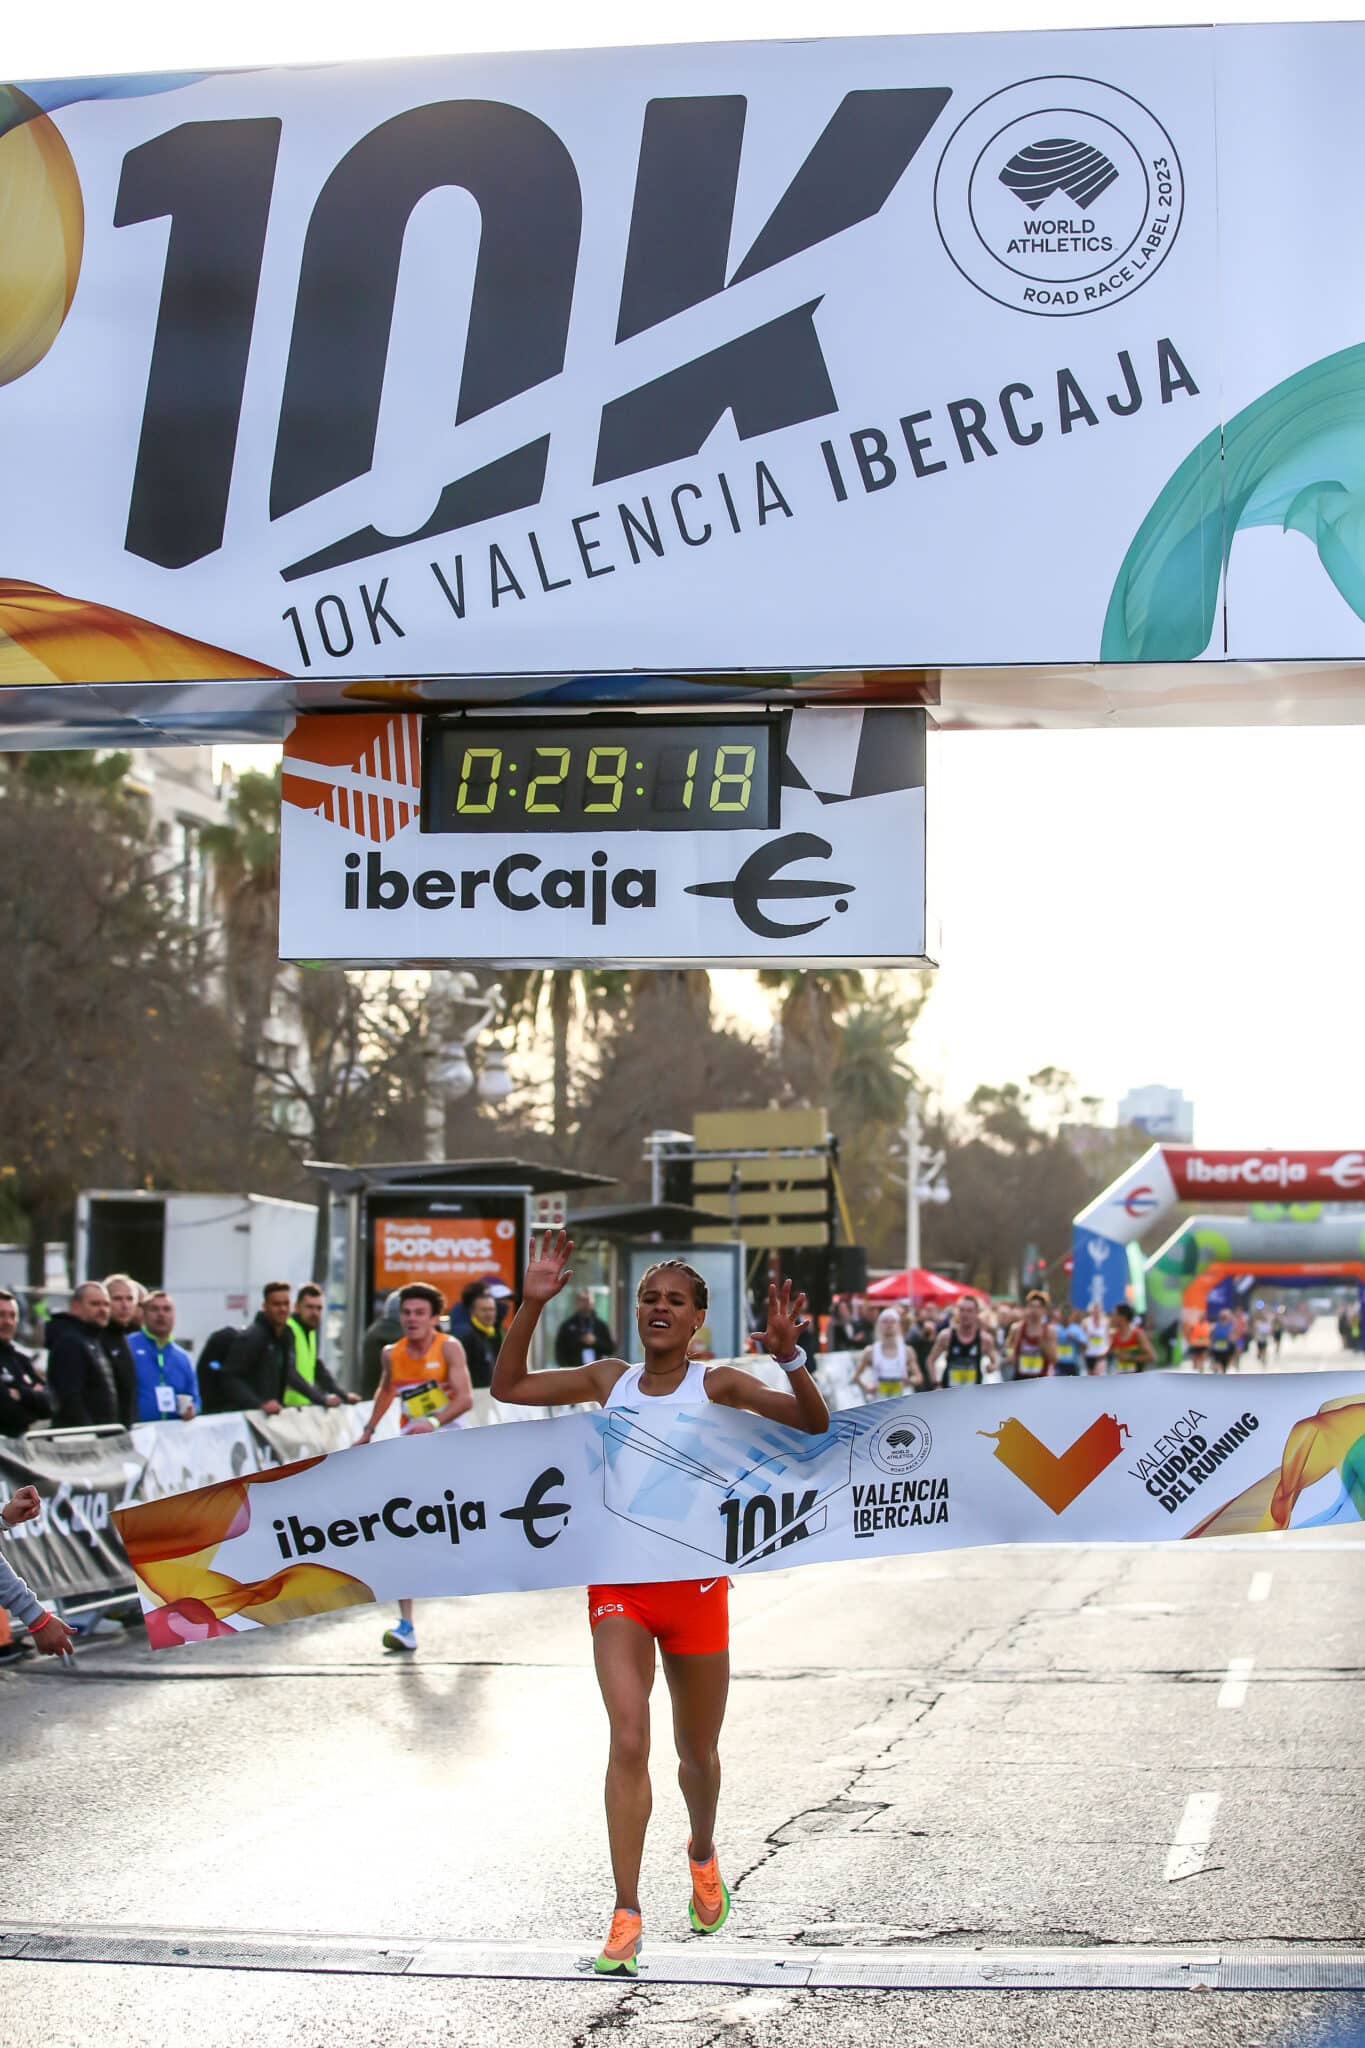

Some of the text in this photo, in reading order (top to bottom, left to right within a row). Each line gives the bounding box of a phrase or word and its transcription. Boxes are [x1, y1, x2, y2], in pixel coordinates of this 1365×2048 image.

[1006, 236, 1114, 254] ATHLETICS
[1023, 219, 1096, 235] WORLD
[1023, 157, 1173, 305] ROAD RACE LABEL 2023
[113, 87, 953, 582] 10K
[280, 337, 1200, 668] 10K VALENCIA IBERCAJA
[456, 745, 756, 814] 0:29:18
[344, 850, 657, 925] iberCaja
[1186, 1156, 1308, 1189] iberCaja
[1127, 1409, 1208, 1481] VALENCIA
[1145, 1434, 1208, 1497] CIUDAD
[1158, 1412, 1260, 1514] DEL RUNNING
[272, 1489, 487, 1560] iberCaja
[852, 1478, 949, 1508] VALENCIA
[853, 1500, 949, 1533] IBERCAJA
[718, 1489, 819, 1569] 10K
